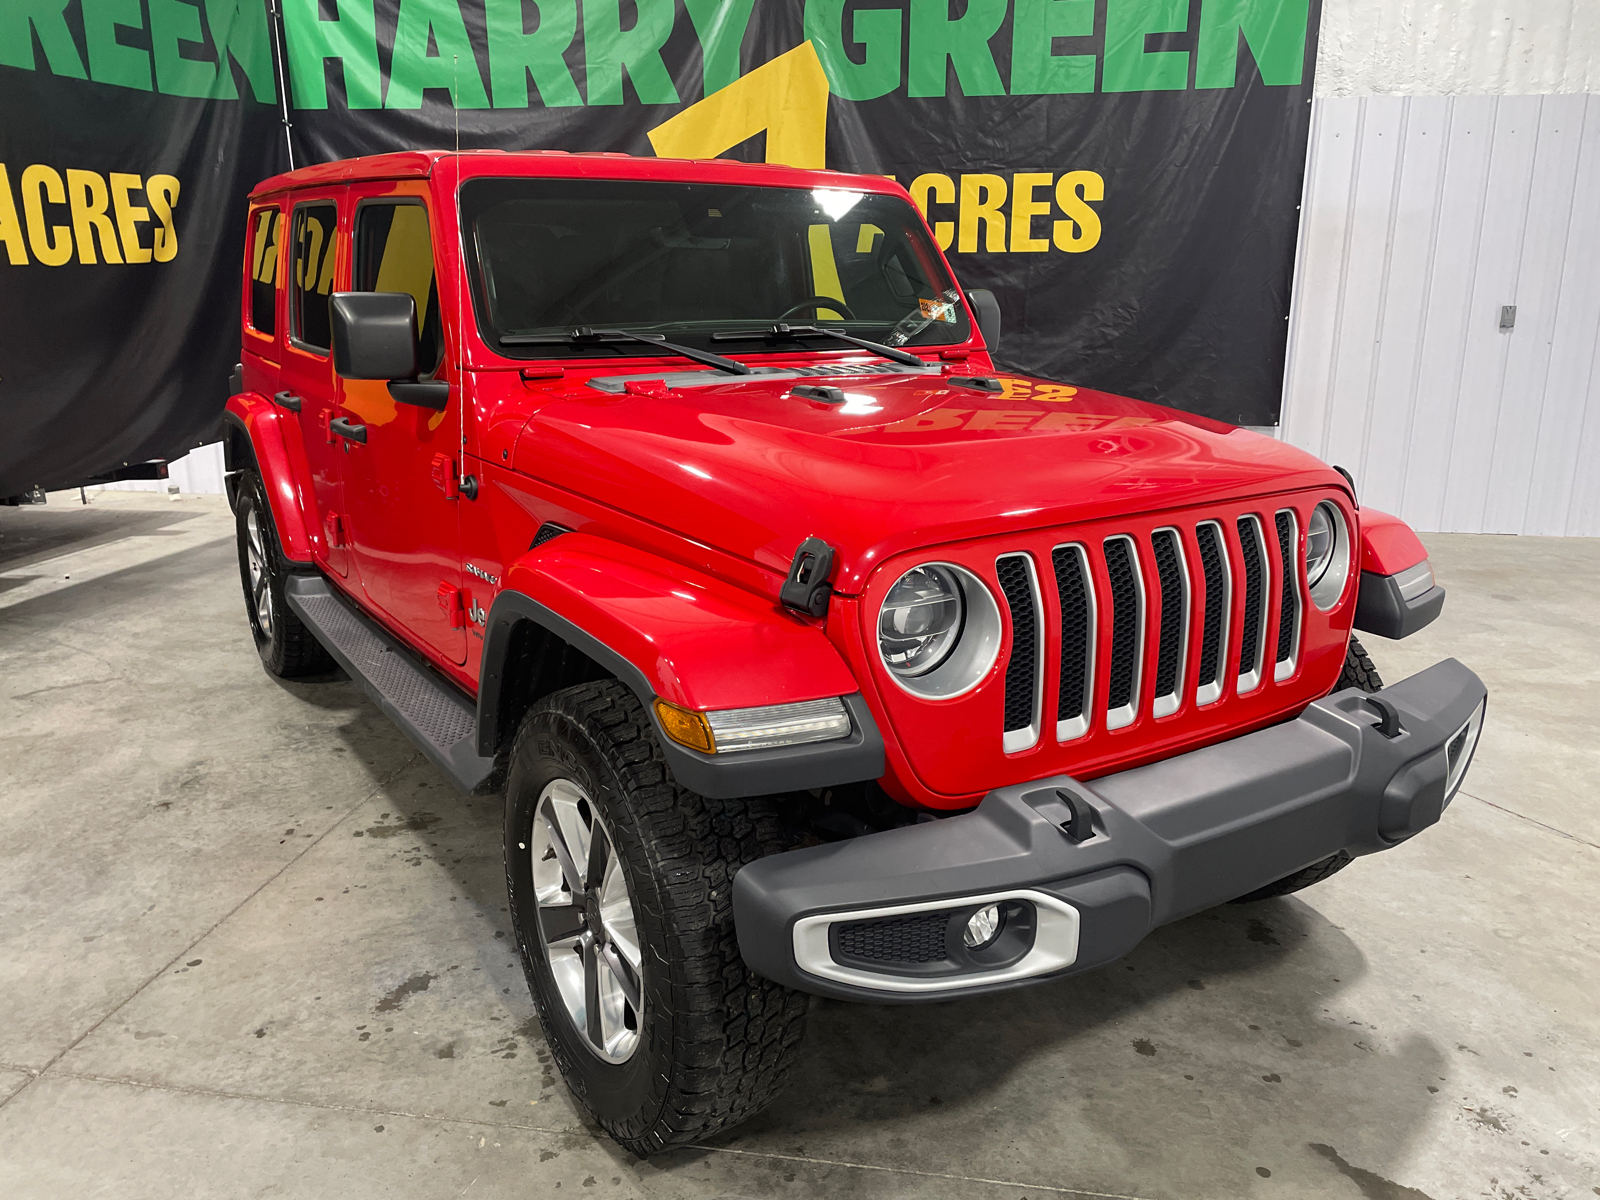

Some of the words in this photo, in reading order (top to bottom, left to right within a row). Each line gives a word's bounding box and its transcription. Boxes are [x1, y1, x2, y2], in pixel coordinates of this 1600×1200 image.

[282, 0, 752, 110] HARRY
[803, 0, 1309, 101] GREEN
[885, 170, 1104, 253] CRES
[468, 598, 487, 627] Je
